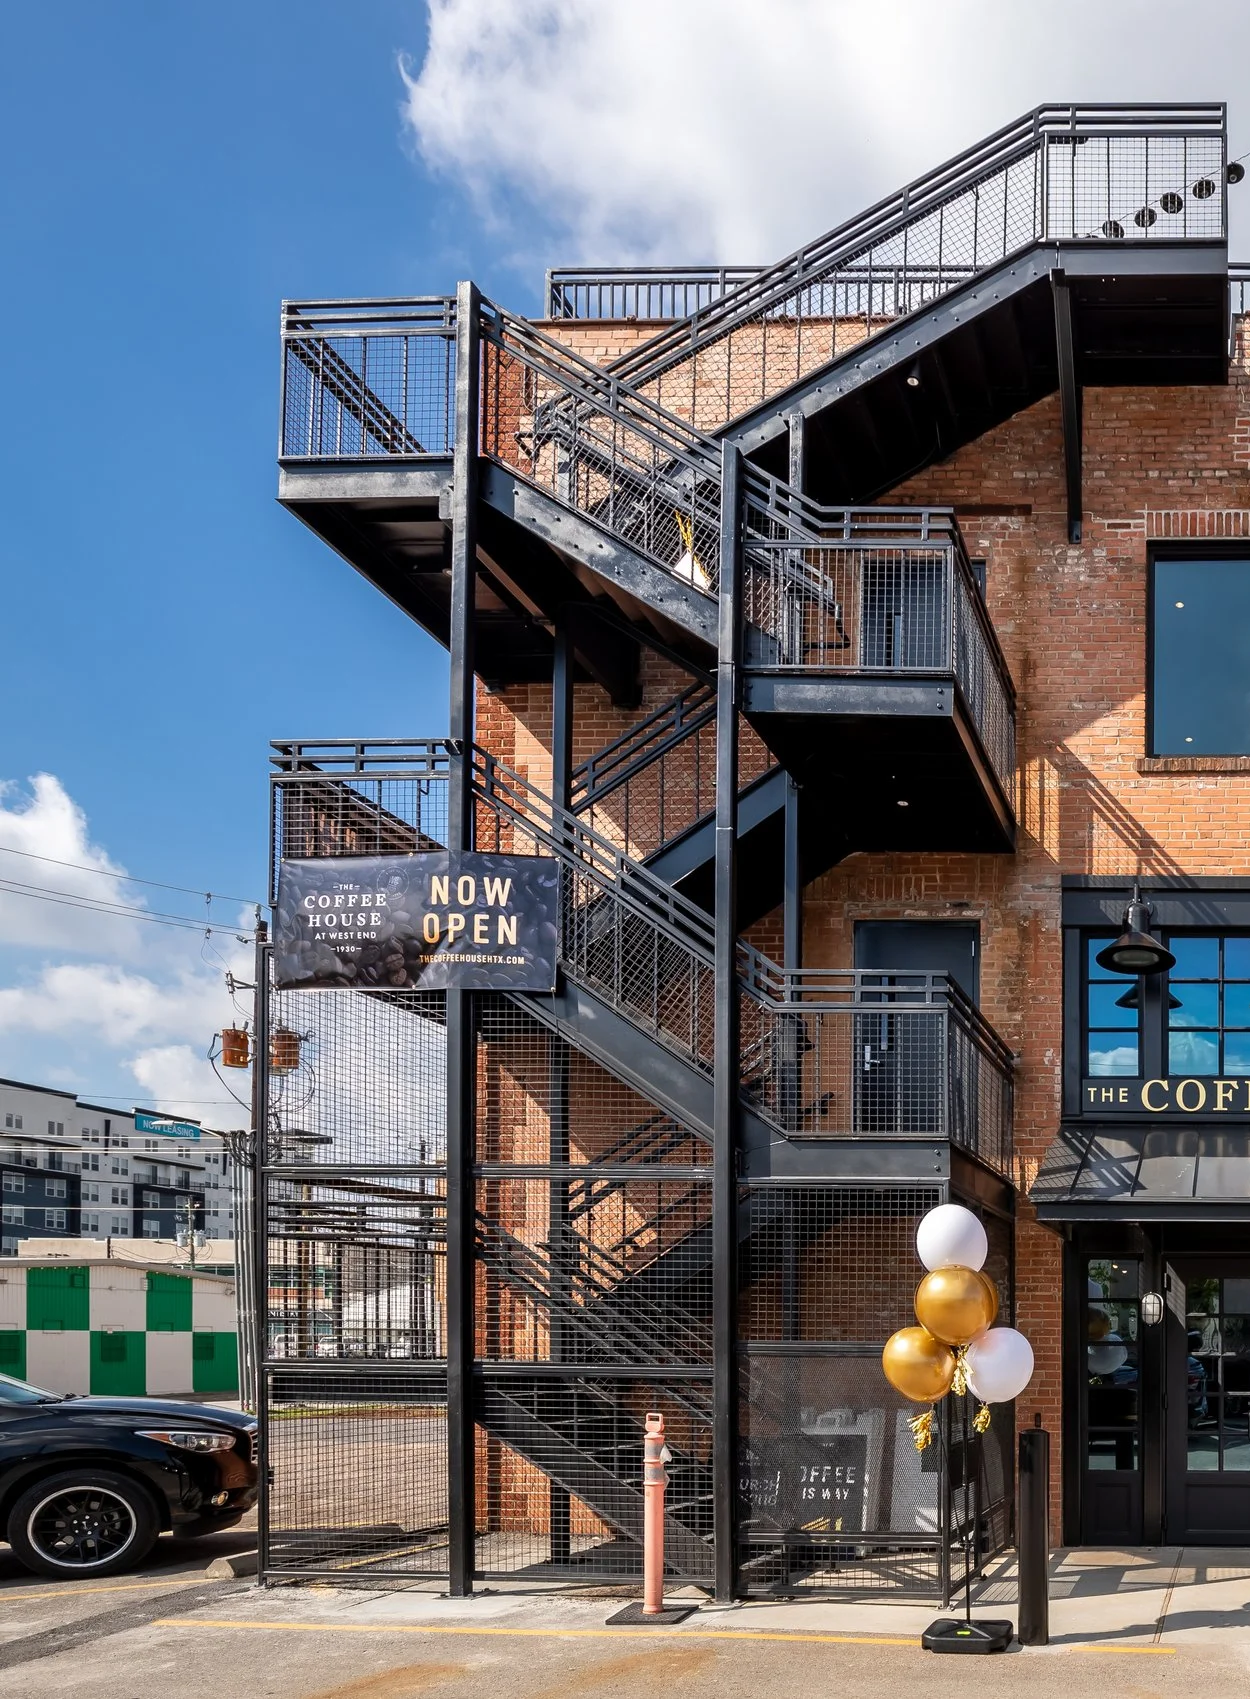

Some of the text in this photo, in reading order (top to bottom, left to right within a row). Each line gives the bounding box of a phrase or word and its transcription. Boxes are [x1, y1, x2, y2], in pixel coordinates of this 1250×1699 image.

[340, 883, 353, 891] THE
[431, 874, 512, 907] NOW
[304, 893, 387, 909] COFFEE
[308, 912, 381, 928] HOUSE
[314, 931, 377, 940] AT WEST END
[422, 912, 518, 945] OPEN
[336, 945, 356, 953] 1930
[419, 953, 525, 965] THECOFFEEHOUSEHTX.COM
[1088, 1087, 1129, 1103] THE
[143, 1119, 195, 1138] NOW LEASING
[822, 1487, 849, 1500] WAY
